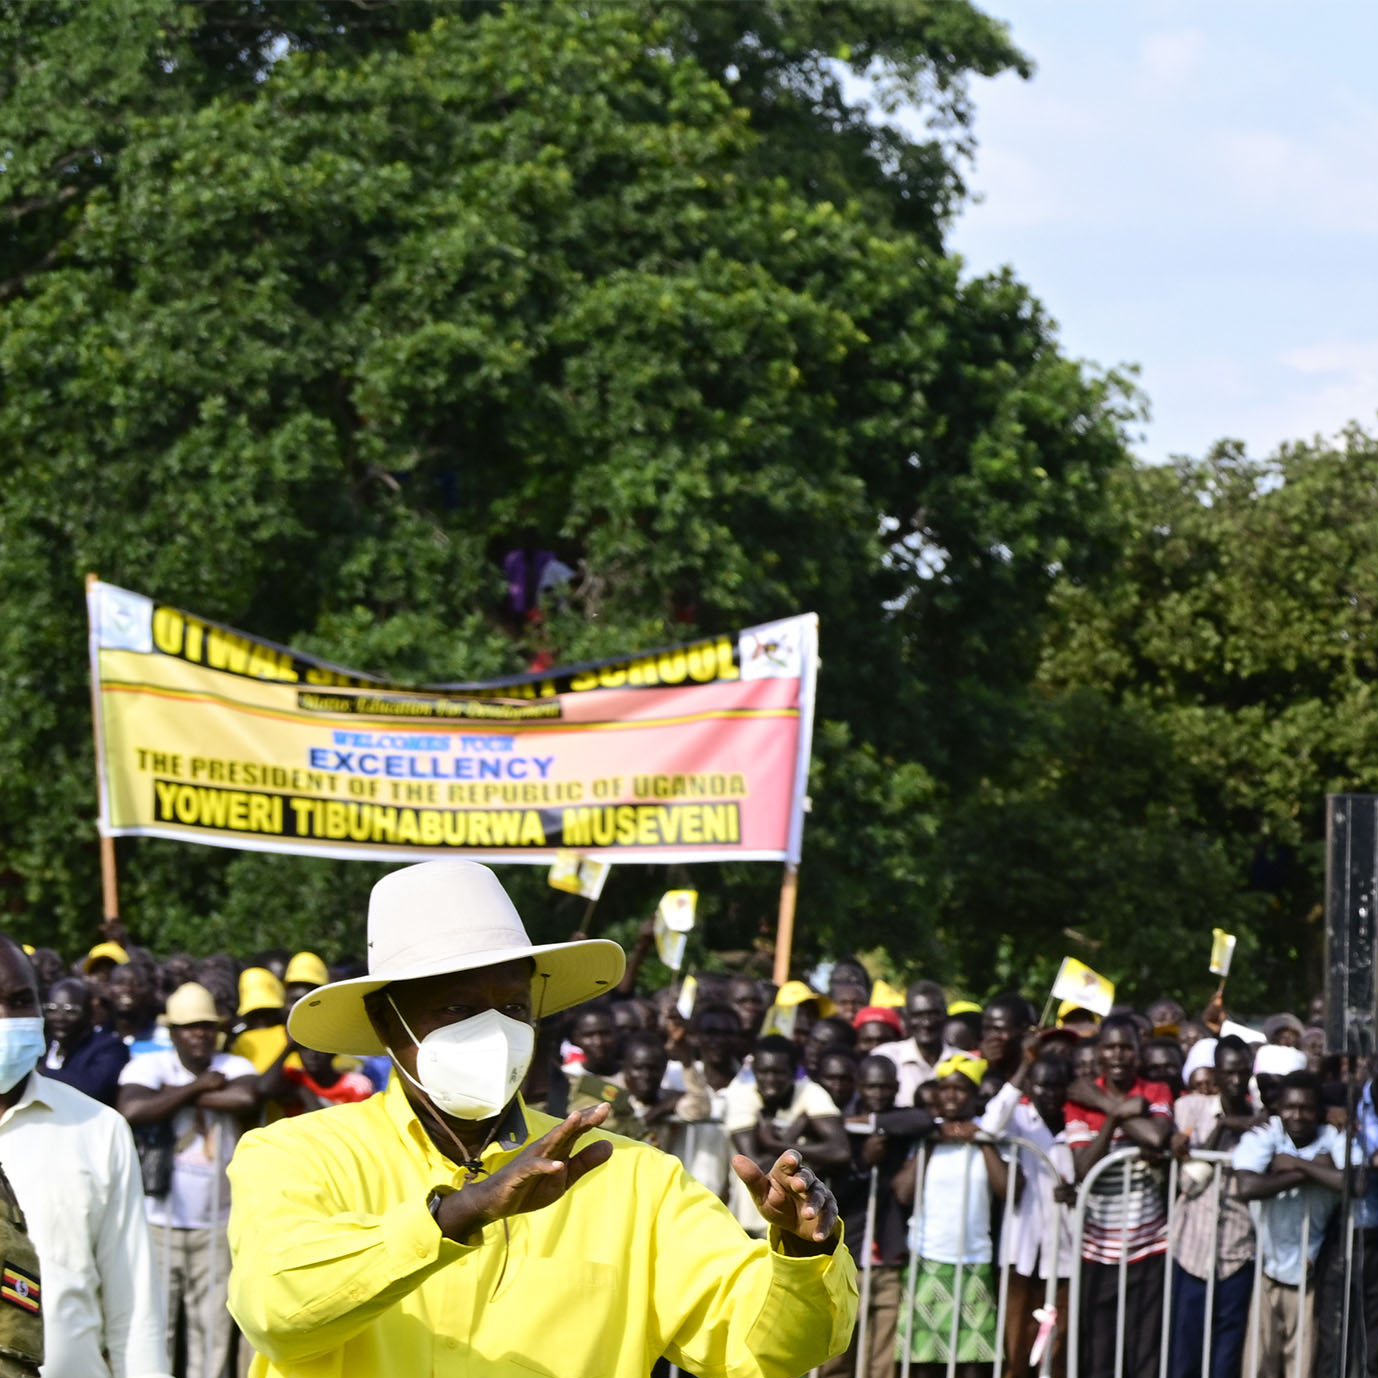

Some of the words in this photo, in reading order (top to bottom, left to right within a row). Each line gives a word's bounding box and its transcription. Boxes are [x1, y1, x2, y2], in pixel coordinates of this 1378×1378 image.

[309, 747, 555, 779] EXCELLENCY
[333, 730, 451, 752] WELCOMES
[459, 735, 516, 752] YOUR
[136, 748, 185, 777] THE
[190, 756, 339, 793] PRESIDENT
[349, 776, 380, 797] OF
[391, 781, 441, 803] THE
[448, 781, 583, 805] REPUBLIC
[593, 776, 625, 799] OF
[633, 773, 746, 798] UGANDA
[155, 780, 284, 834] YOWERI
[290, 797, 547, 846] TIBUHABURWA
[562, 802, 741, 846] MUSEVENI
